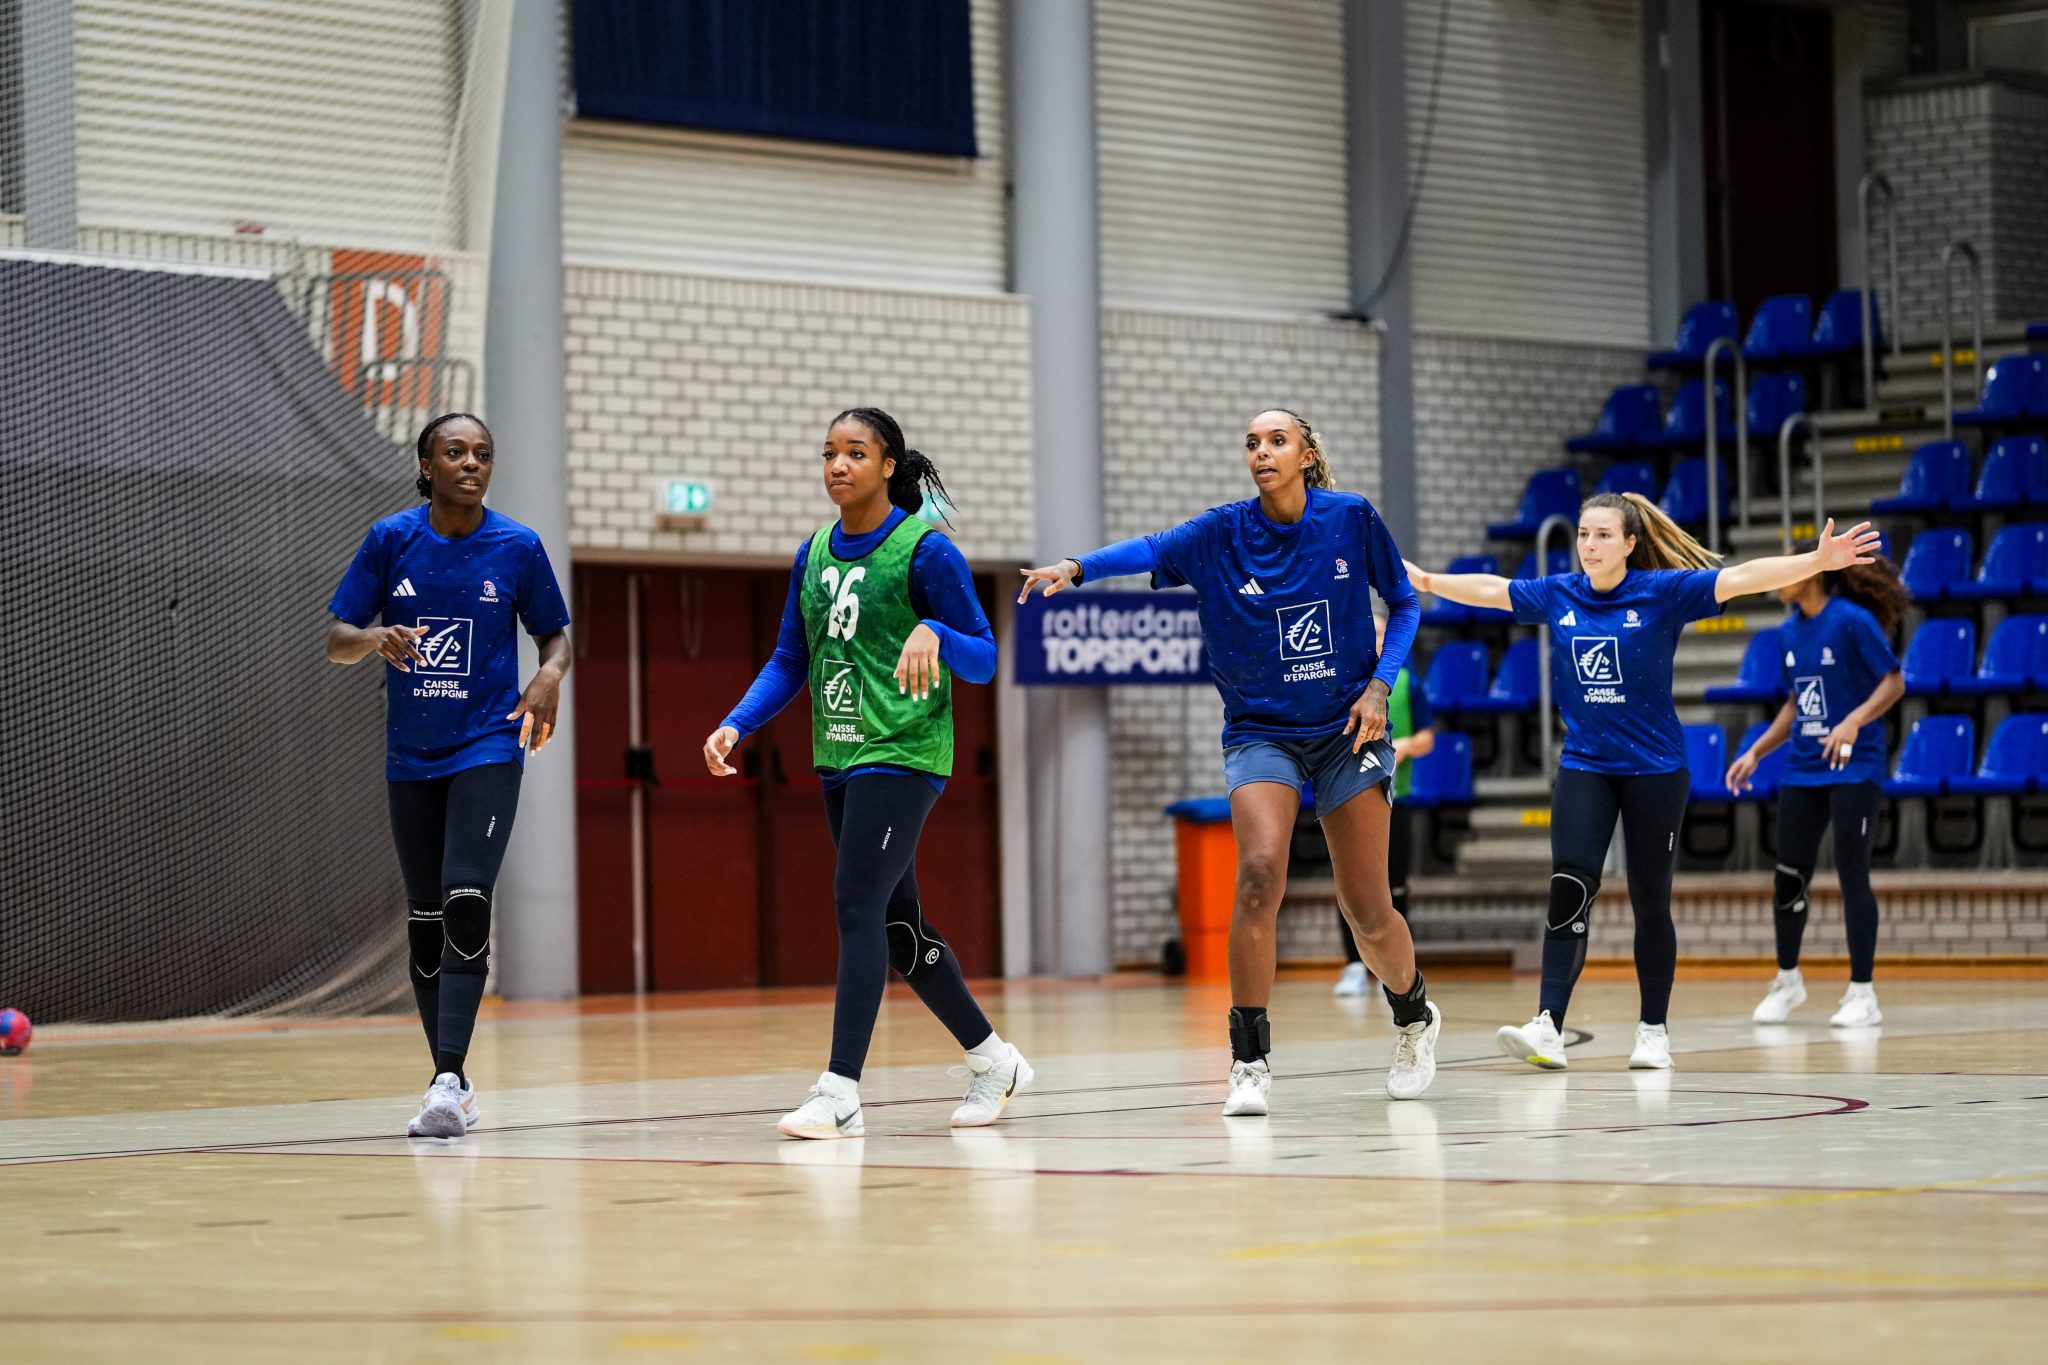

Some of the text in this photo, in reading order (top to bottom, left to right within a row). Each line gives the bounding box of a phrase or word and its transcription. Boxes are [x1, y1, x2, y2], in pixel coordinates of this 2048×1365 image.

[1042, 604, 1200, 638] rotterdam
[1043, 636, 1203, 674] TOPSPORT
[1291, 660, 1325, 673] CAISSE
[423, 680, 460, 689] CAISSE
